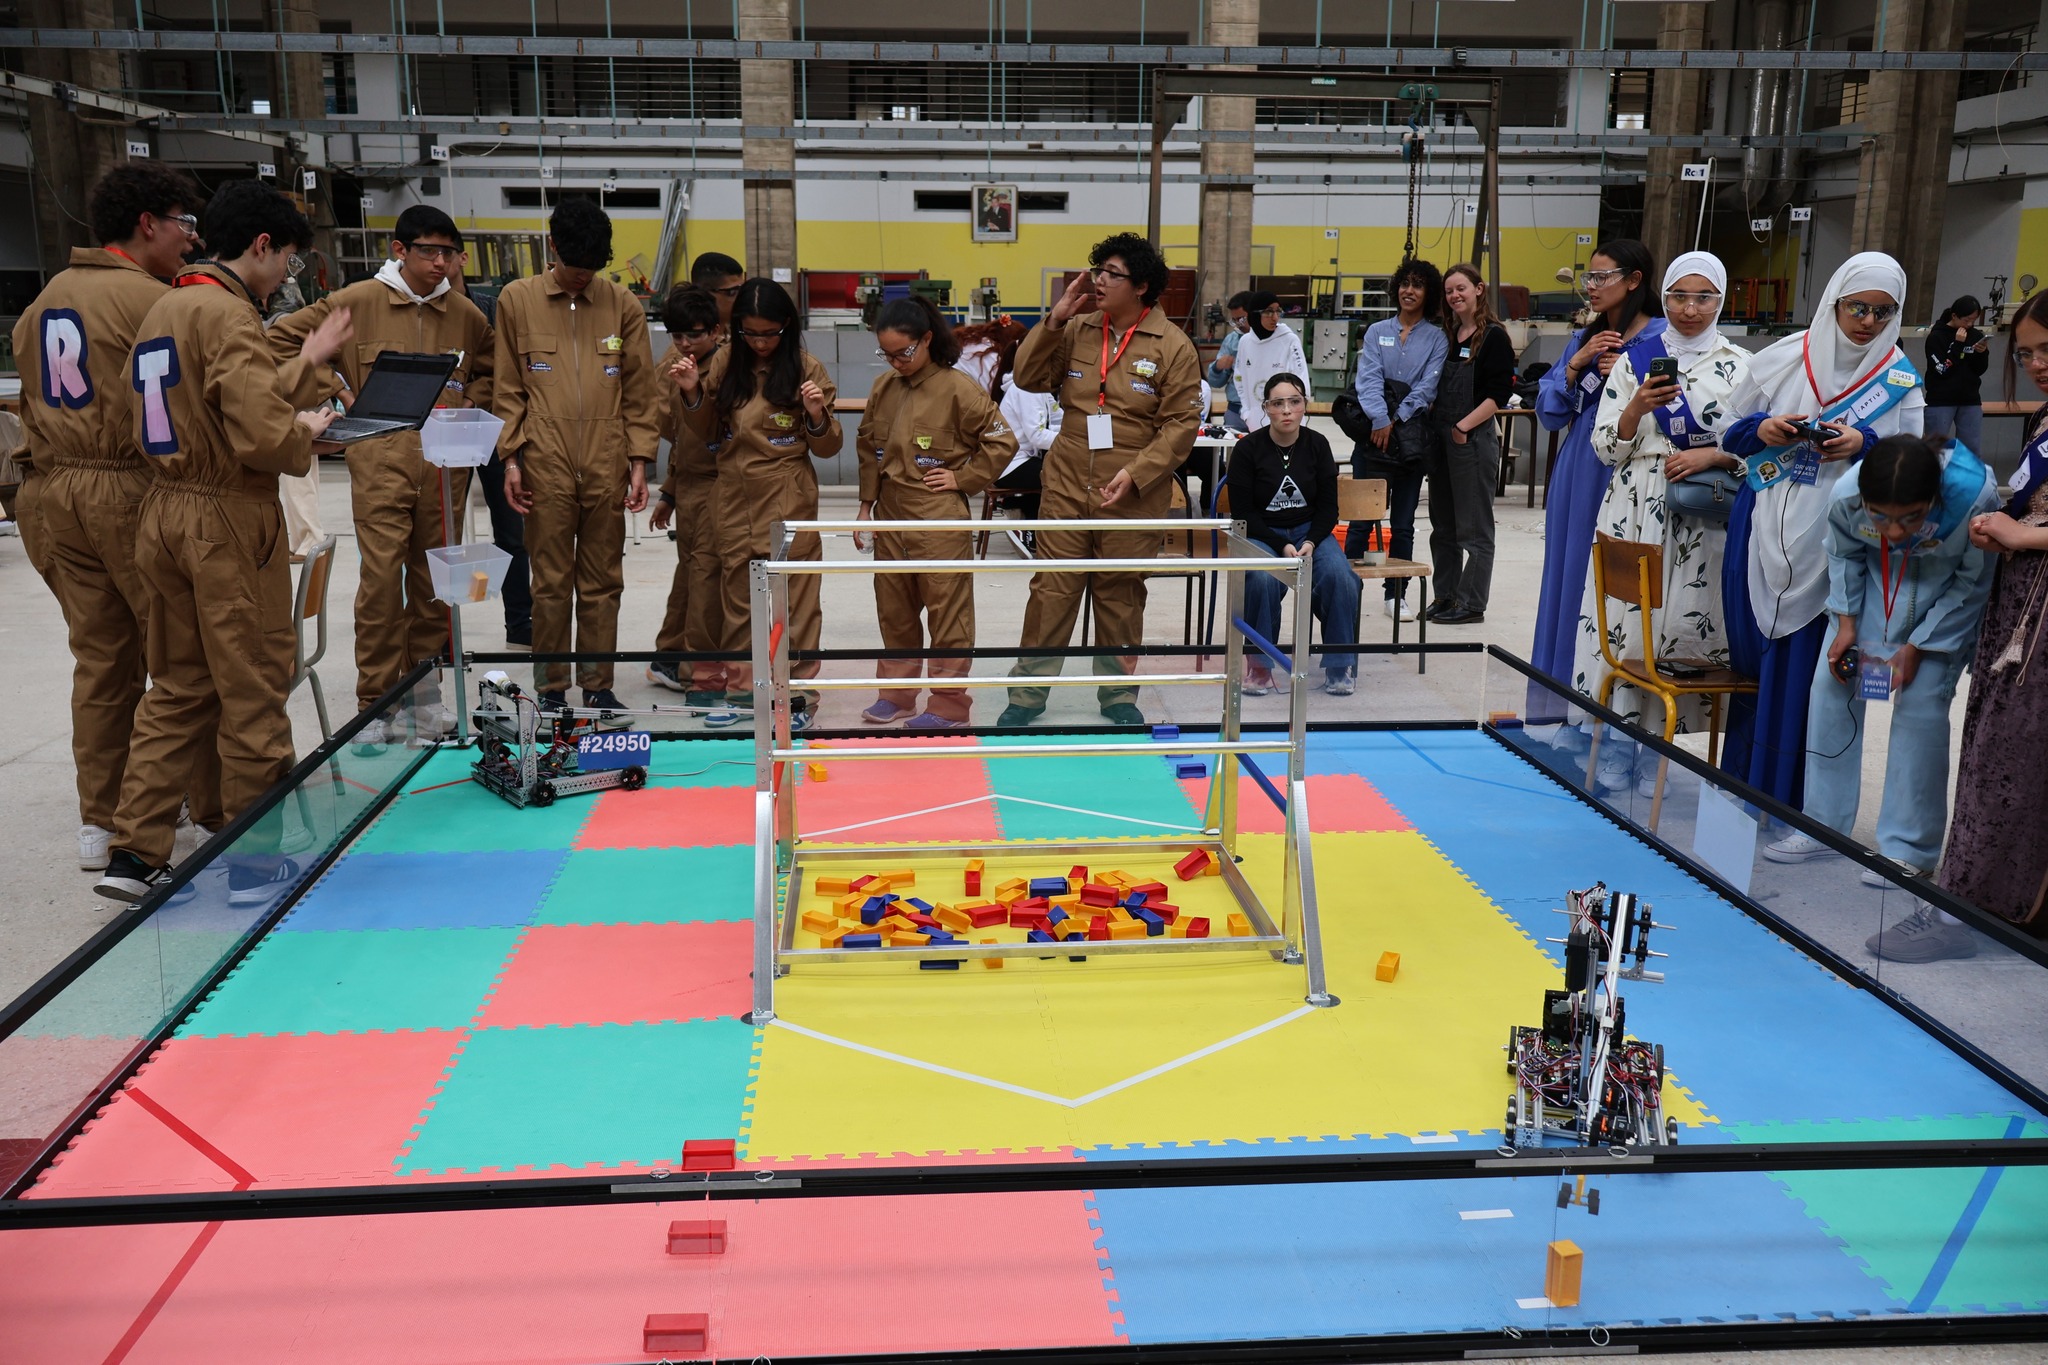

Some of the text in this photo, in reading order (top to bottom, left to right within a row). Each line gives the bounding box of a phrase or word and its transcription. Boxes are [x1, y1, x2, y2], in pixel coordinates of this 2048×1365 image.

[1684, 168, 1696, 177] Rc
[43, 311, 93, 407] R
[1894, 371, 1912, 381] 25433
[134, 339, 178, 452] T
[1860, 391, 1882, 411] APTIV
[1795, 463, 1817, 473] DRIVER
[579, 733, 651, 754] #24950
